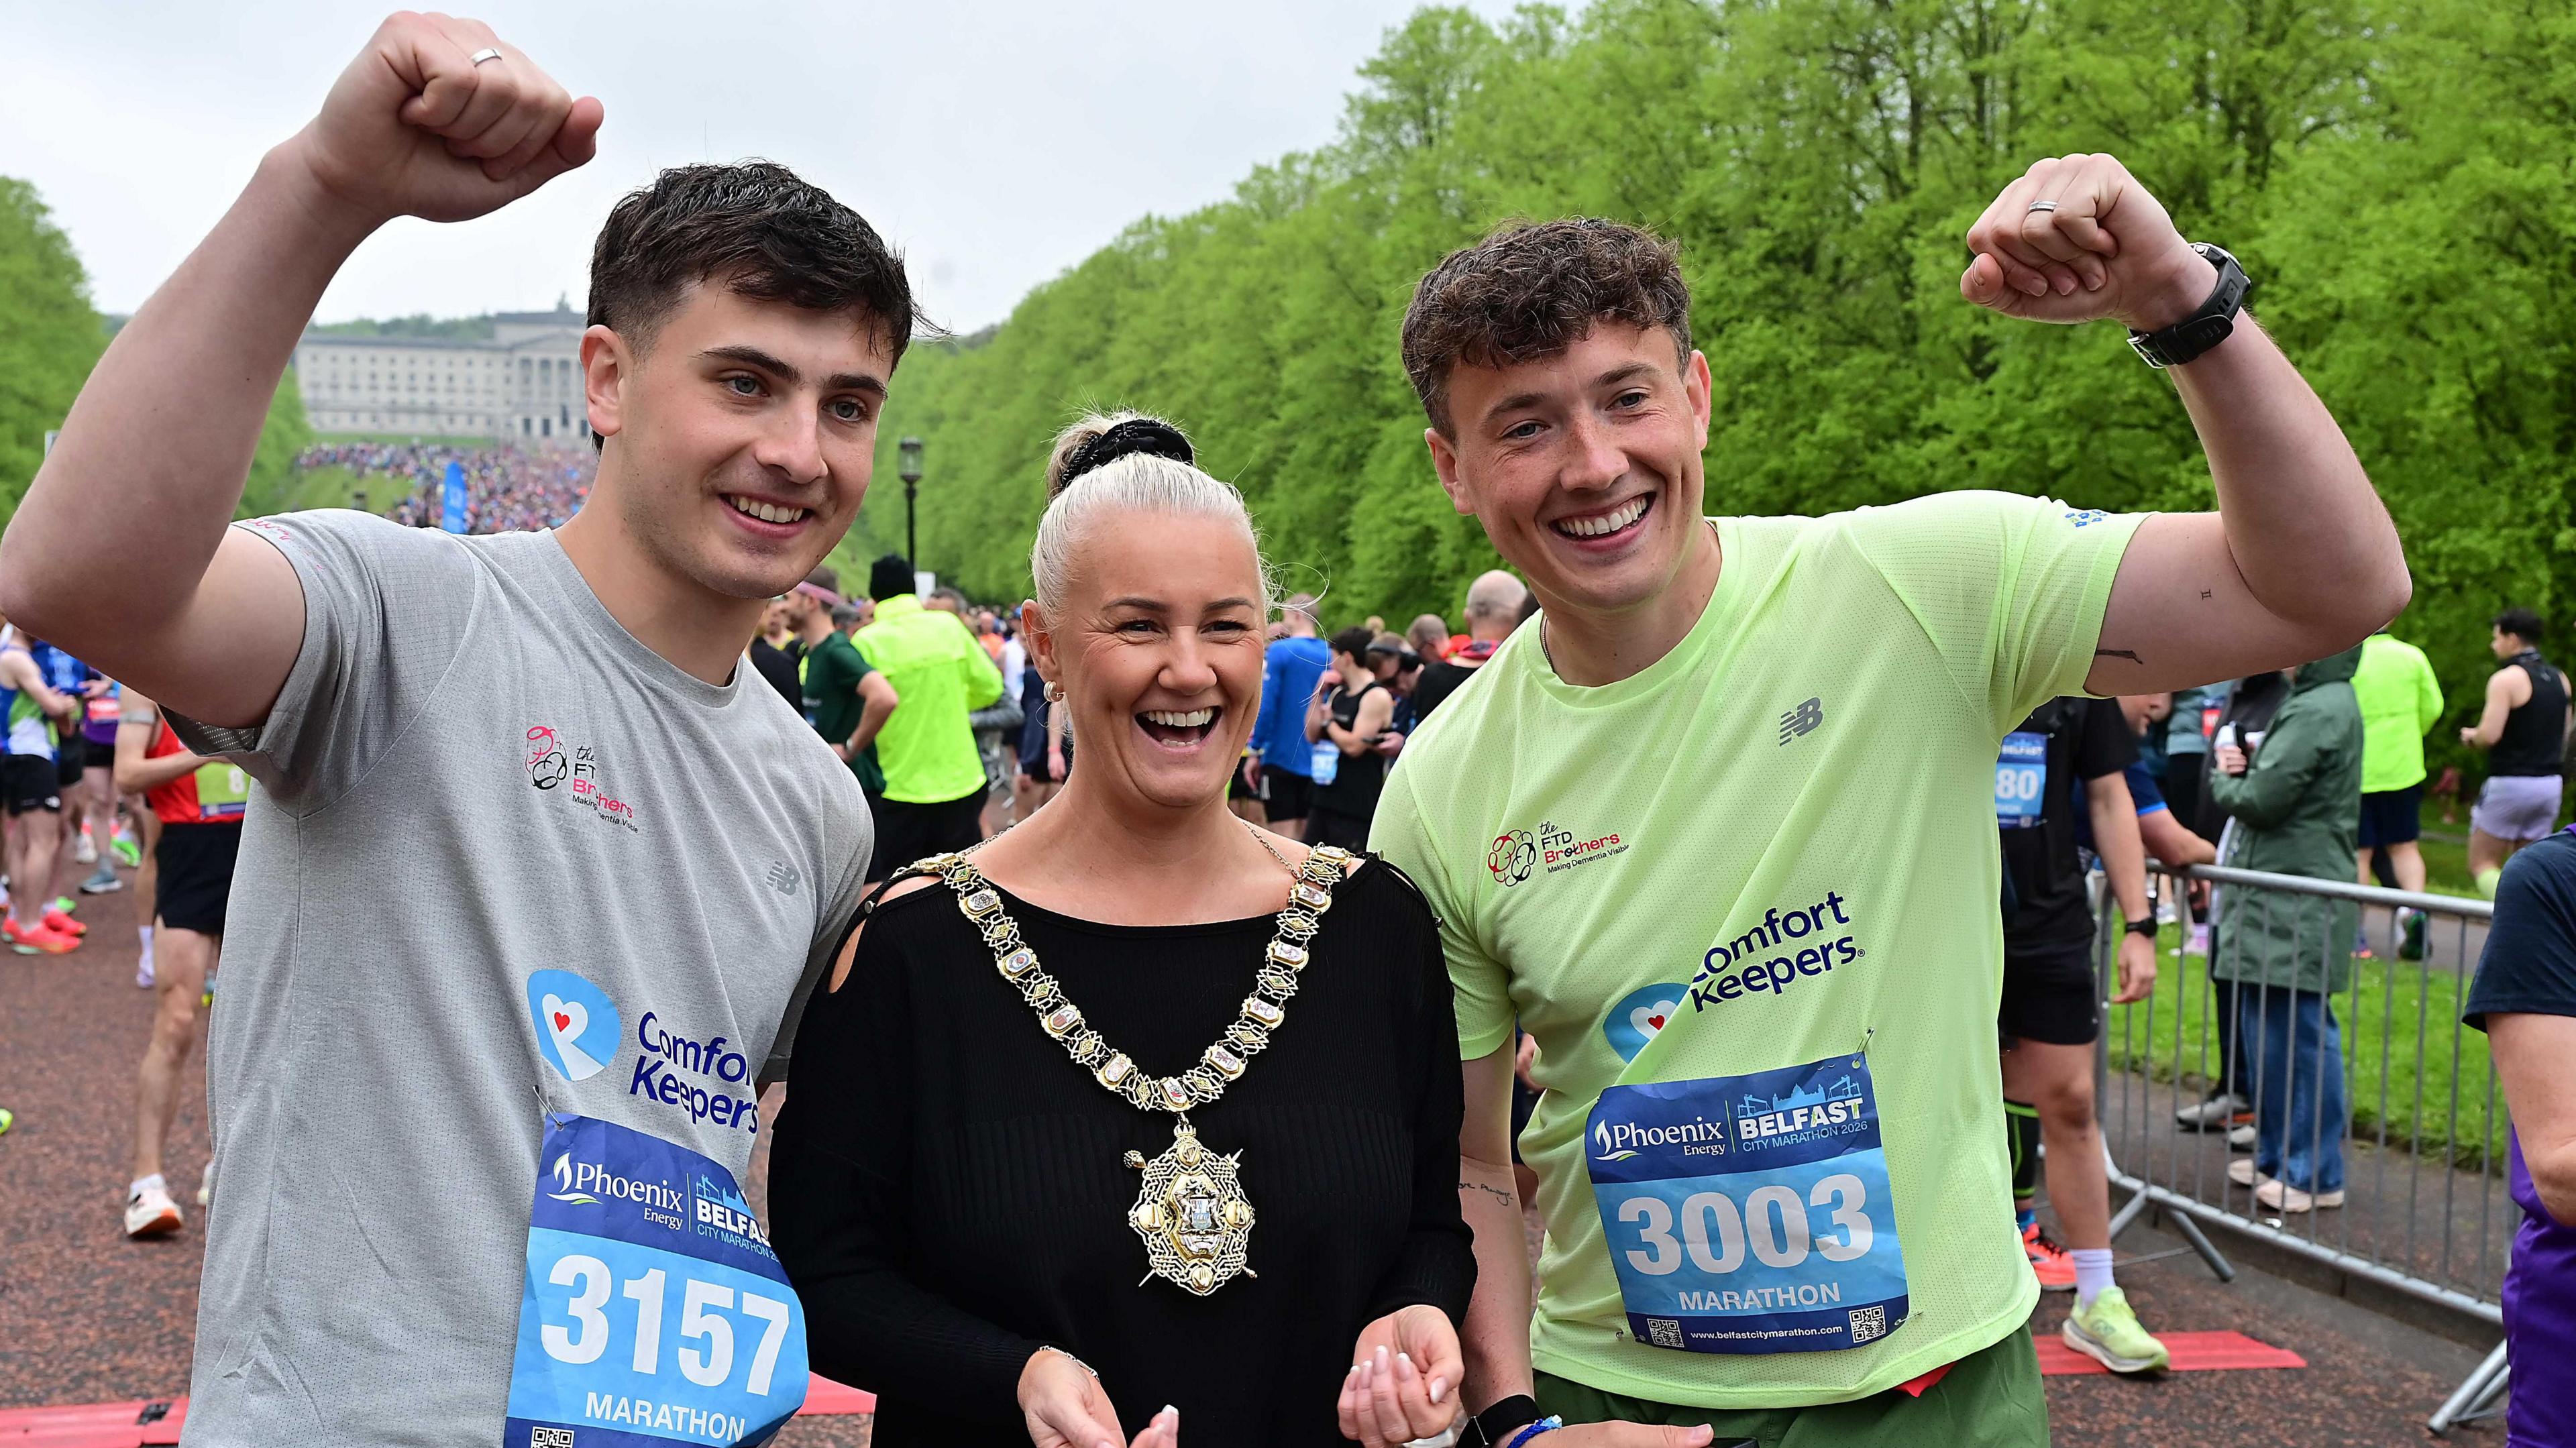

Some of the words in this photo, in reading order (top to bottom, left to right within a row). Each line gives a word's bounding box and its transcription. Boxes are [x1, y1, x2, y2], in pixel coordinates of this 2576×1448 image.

[577, 746, 595, 761] the
[575, 763, 596, 779] FT
[573, 778, 633, 818] Brhers
[1540, 821, 1558, 836] the
[1541, 832, 1572, 850] FTD
[1544, 834, 1620, 864] Brothers
[1548, 862, 1571, 873] Making
[1572, 852, 1607, 866] Dementia
[1607, 844, 1629, 856] Visible
[1692, 891, 1849, 983] omfort
[639, 1011, 750, 1086] Comfo
[629, 1055, 758, 1134] Keepers
[1614, 1116, 1724, 1149] Phoenix
[1739, 1099, 1864, 1140] BELFAST
[1684, 1142, 1725, 1156] Energy
[1743, 1139, 1769, 1152] CITY
[1771, 1126, 1838, 1149] MARATHON
[1841, 1121, 1868, 1135] 2026
[576, 1162, 684, 1213] Phoenix
[643, 1208, 684, 1231] Energy
[696, 1198, 771, 1247] BELFAS
[1618, 1174, 1874, 1275] 3003
[698, 1224, 718, 1239] CITY
[720, 1231, 769, 1258] MARATHON
[1678, 1282, 1841, 1311] MARATHON
[541, 1254, 790, 1396] 3157
[1690, 1324, 1843, 1340] www.belfastcitymarathon.com
[585, 1392, 745, 1443] MARATHON
